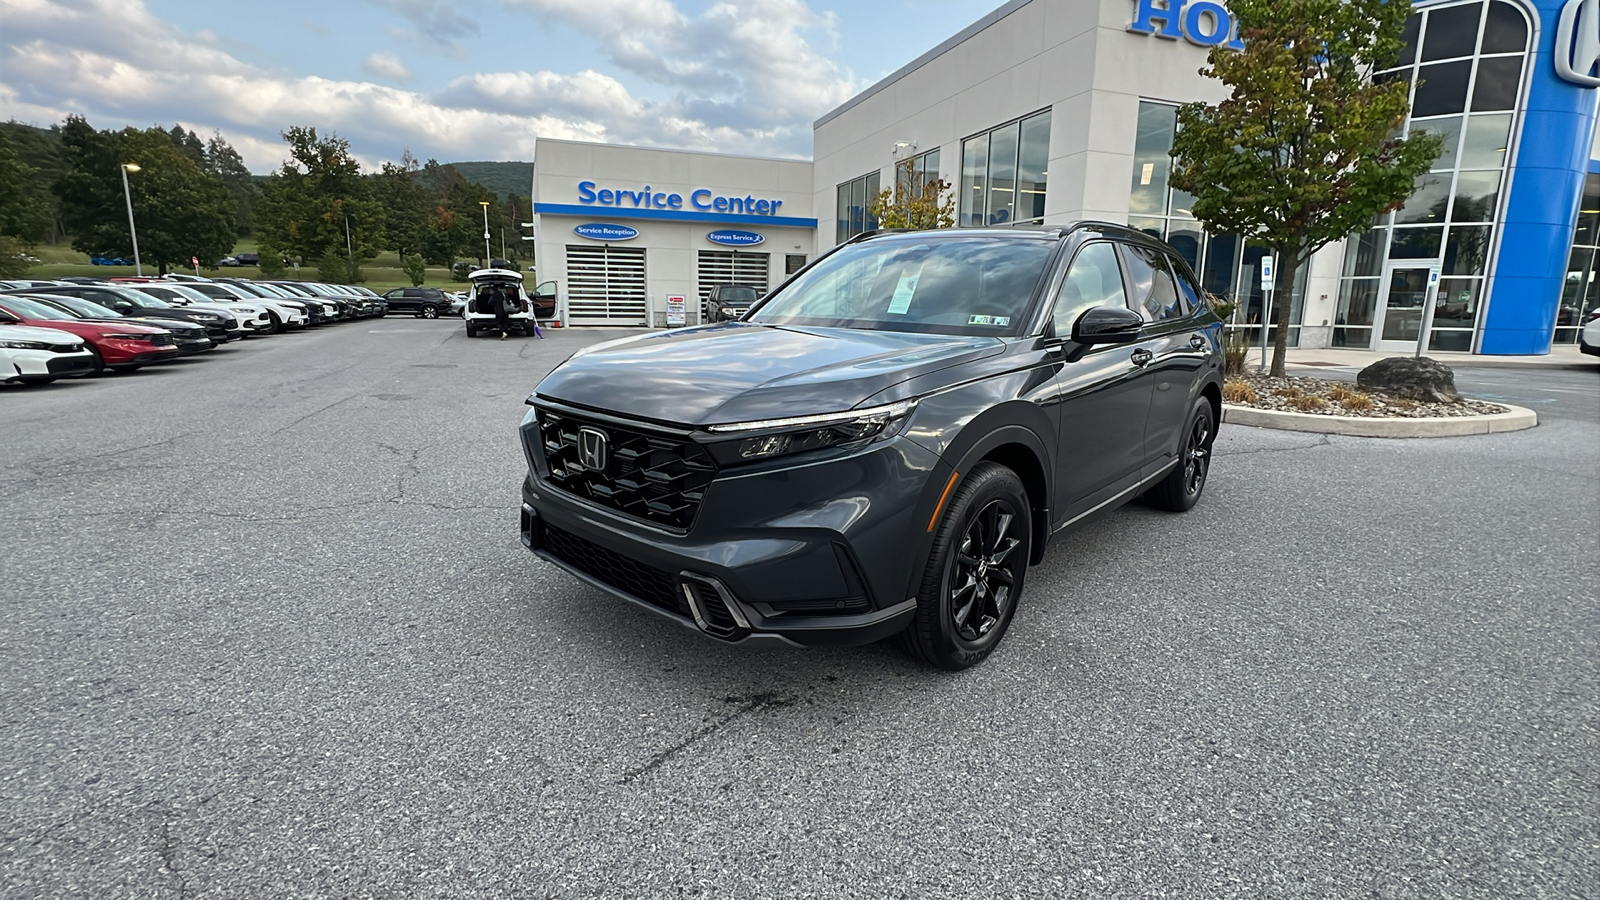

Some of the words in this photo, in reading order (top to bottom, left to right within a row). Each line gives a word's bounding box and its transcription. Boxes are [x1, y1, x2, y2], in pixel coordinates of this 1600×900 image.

[577, 181, 683, 209] Service
[690, 188, 783, 215] Center
[577, 226, 602, 234] Service
[603, 227, 635, 236] Reception
[710, 233, 731, 241] Express
